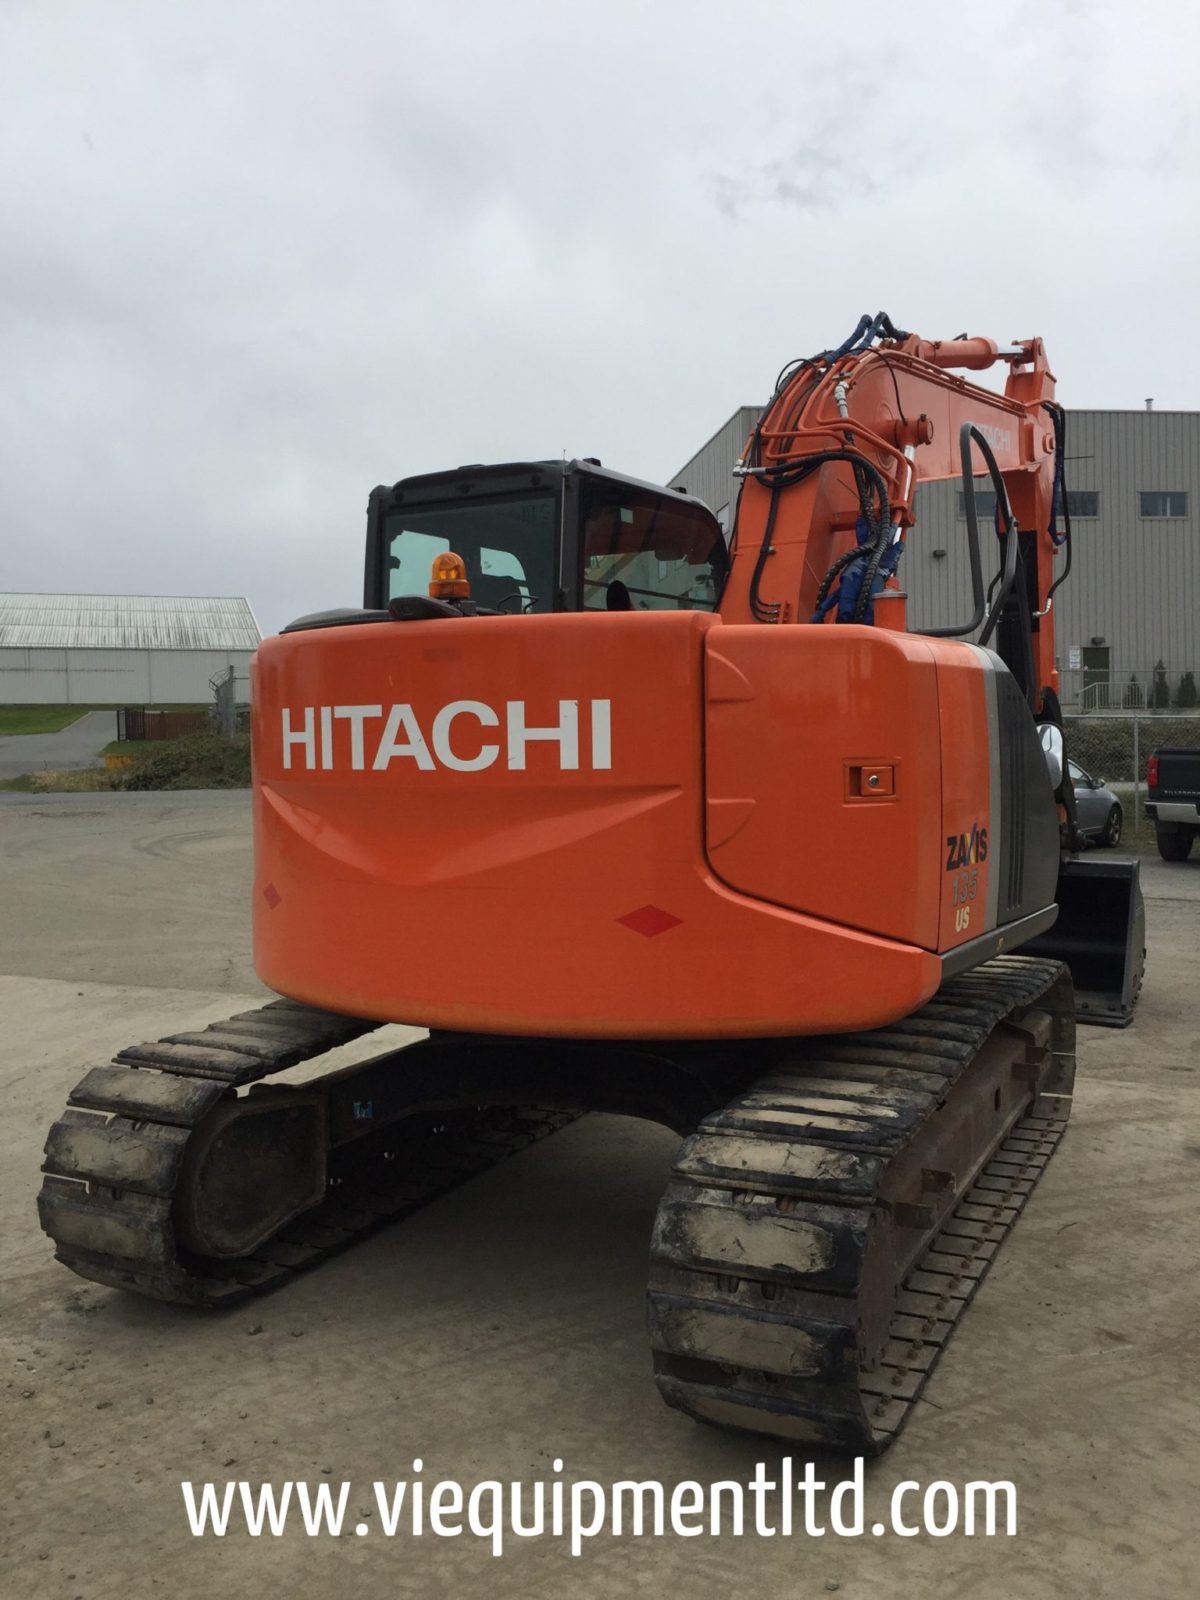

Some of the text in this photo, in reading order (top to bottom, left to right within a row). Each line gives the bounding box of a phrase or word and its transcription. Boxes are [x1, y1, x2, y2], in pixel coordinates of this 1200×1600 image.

[281, 699, 612, 772] HITACHI
[946, 823, 988, 871] ZAXIS
[952, 868, 978, 906] 135
[955, 905, 970, 932] US
